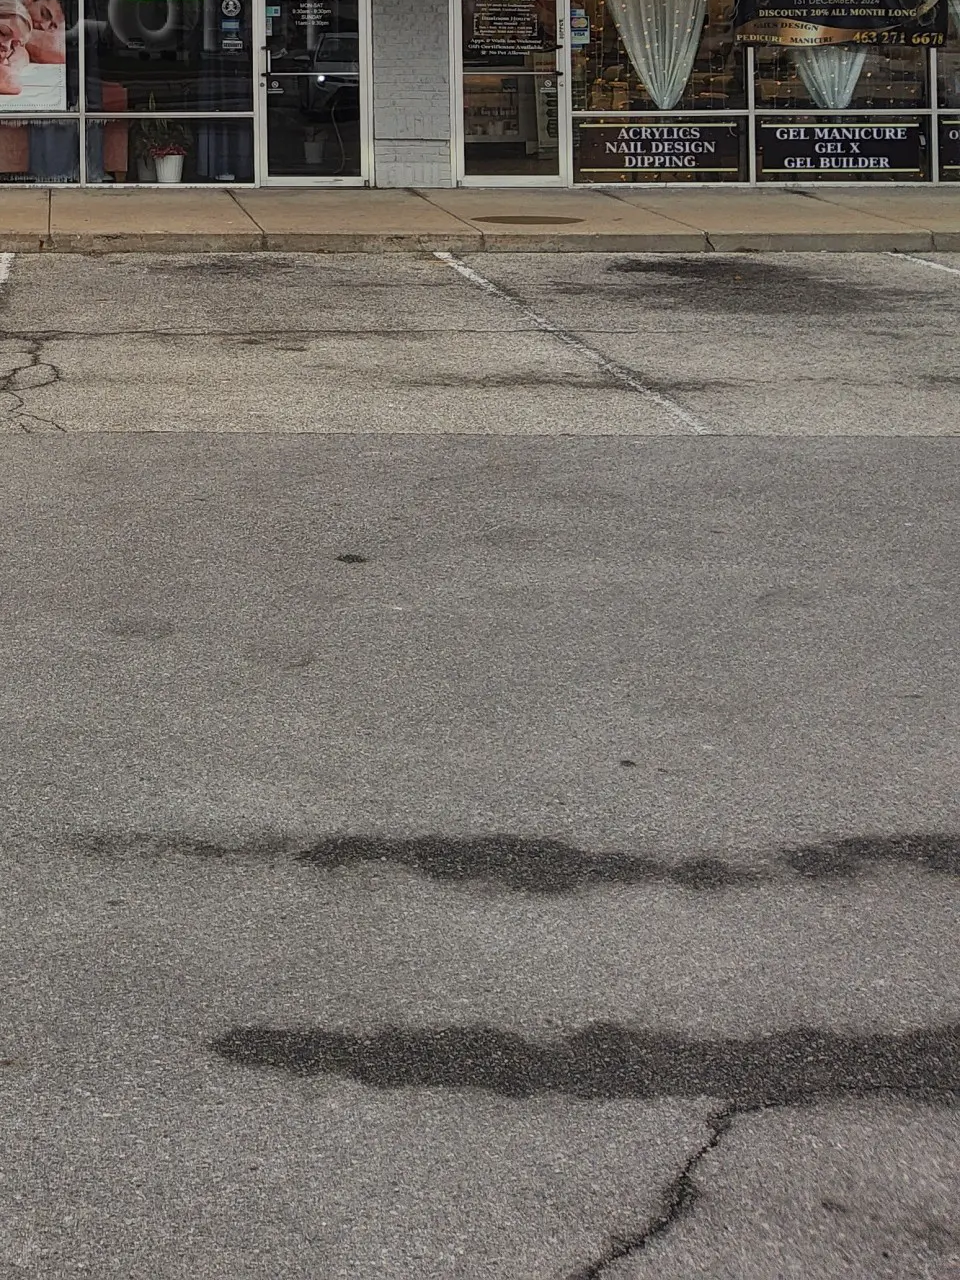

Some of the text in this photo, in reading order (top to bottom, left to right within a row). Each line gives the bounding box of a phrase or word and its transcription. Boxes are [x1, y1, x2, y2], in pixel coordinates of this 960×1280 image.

[759, 9, 808, 17] DISCOUNT
[810, 9, 829, 17] 20%
[781, 22, 819, 31] DESIGN
[736, 34, 834, 44] PEDICURE MANICURE
[853, 32, 944, 45] 463 271 6678
[617, 127, 701, 140] ACRYLICS
[775, 127, 908, 140] GEL MANICURE
[949, 130, 960, 140] O
[605, 141, 716, 154] NAIL DESIGN
[814, 142, 861, 154] GEL X
[624, 155, 696, 168] DIPPING
[784, 157, 891, 168] GEL BUILDER
